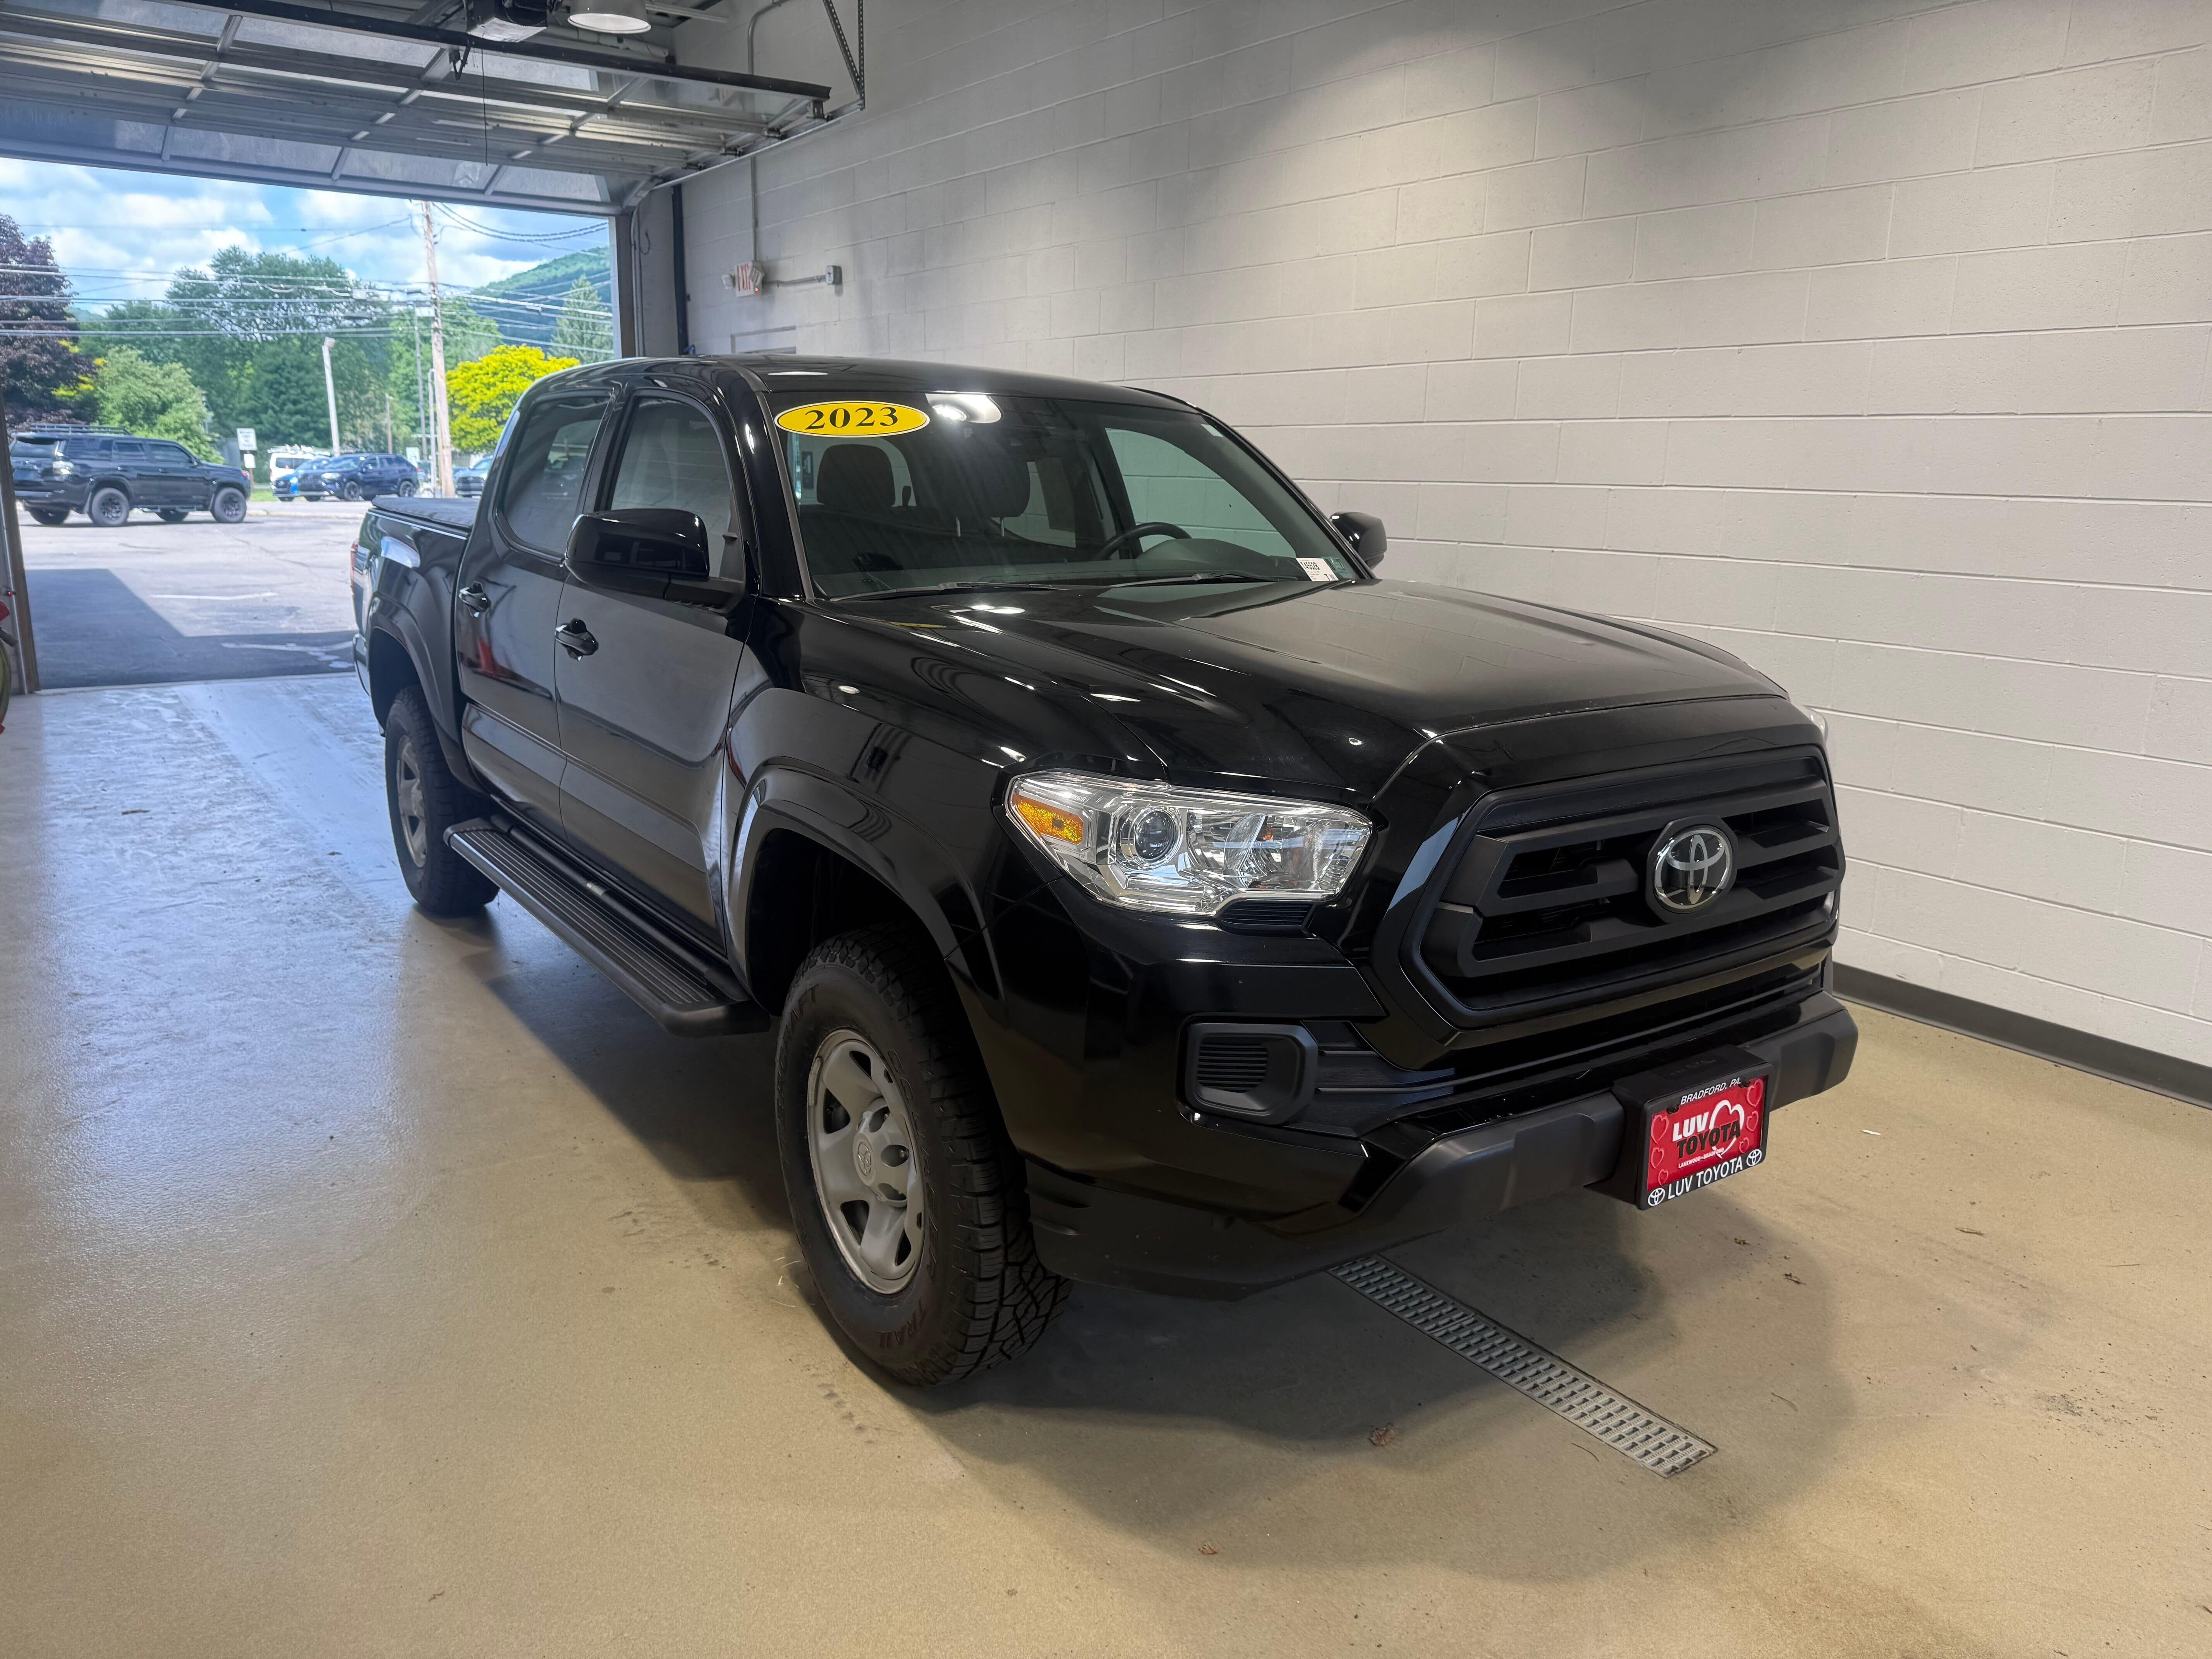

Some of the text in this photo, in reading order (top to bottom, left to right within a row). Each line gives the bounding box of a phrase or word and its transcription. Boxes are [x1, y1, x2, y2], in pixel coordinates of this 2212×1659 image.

[805, 407, 898, 430] 2023
[1729, 1077, 1741, 1088] PA.
[1672, 1111, 1709, 1142] LUV
[1676, 1120, 1741, 1159] TOYOTA
[1668, 1156, 1743, 1199] LUV TOYOTA
